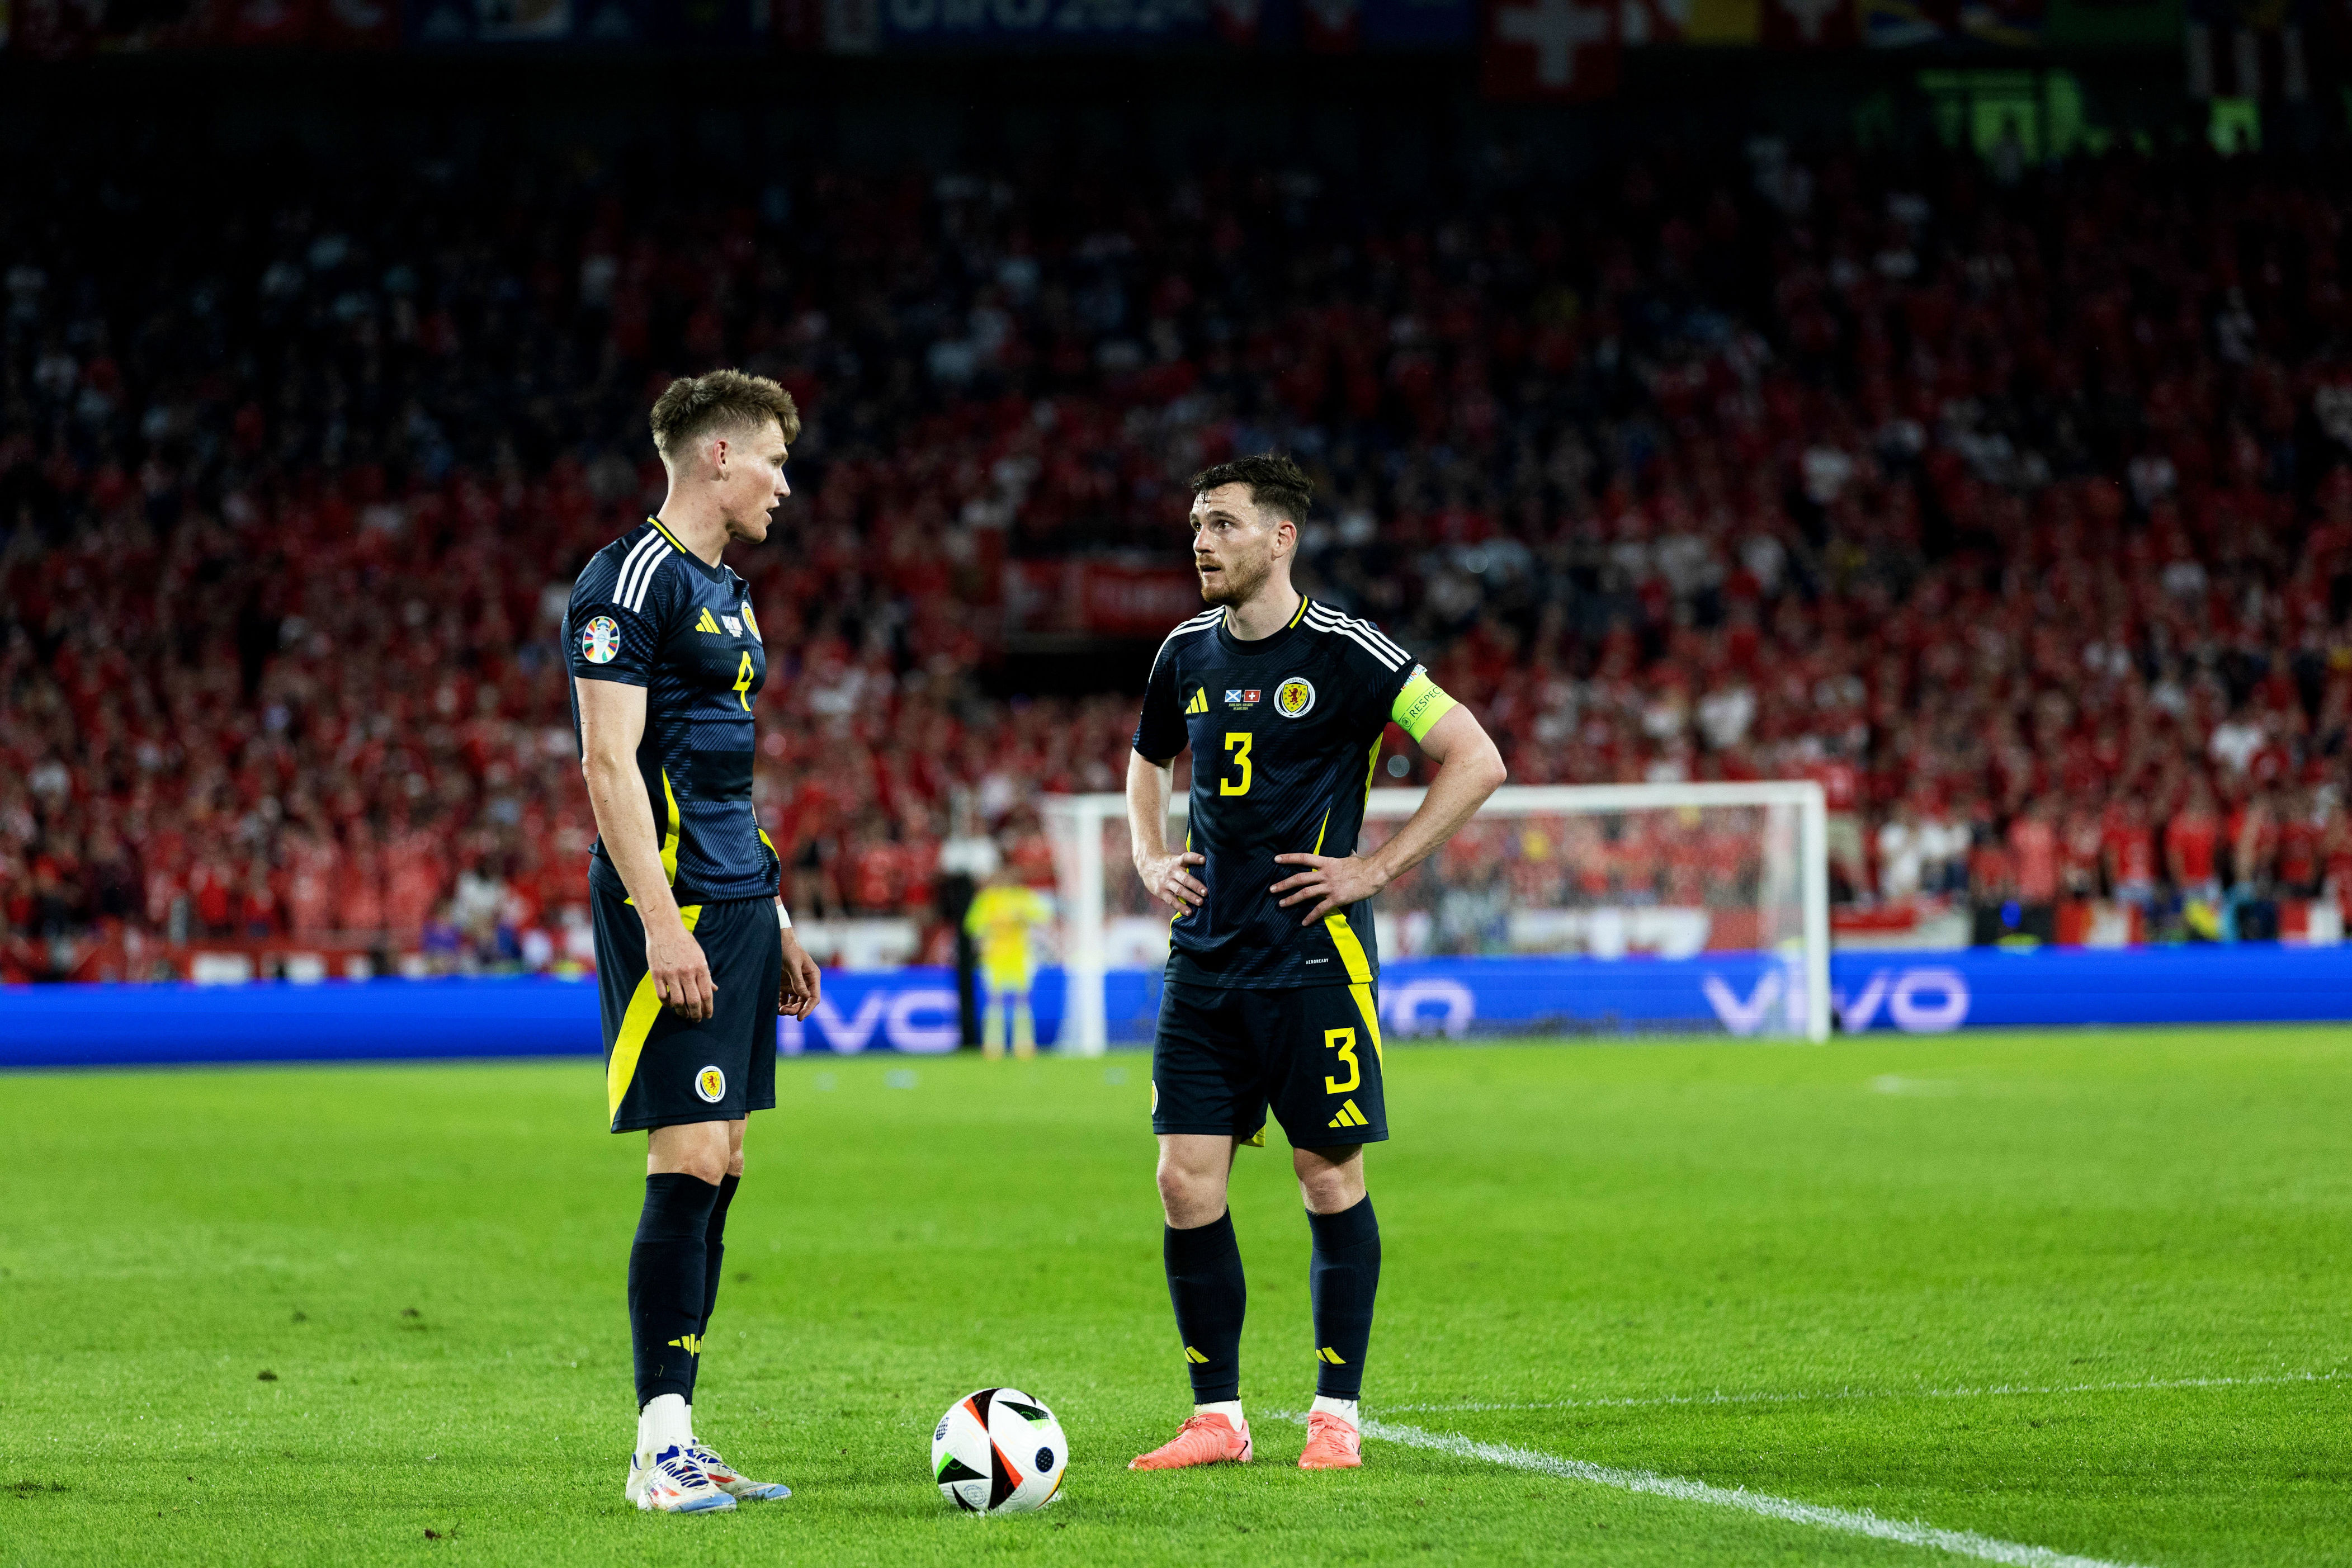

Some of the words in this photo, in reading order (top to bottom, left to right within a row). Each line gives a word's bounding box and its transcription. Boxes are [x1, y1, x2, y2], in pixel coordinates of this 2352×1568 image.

[732, 651, 754, 711] 4
[1220, 733, 1253, 796] 3
[777, 989, 961, 1055] ivo
[1324, 1027, 1360, 1094] 3
